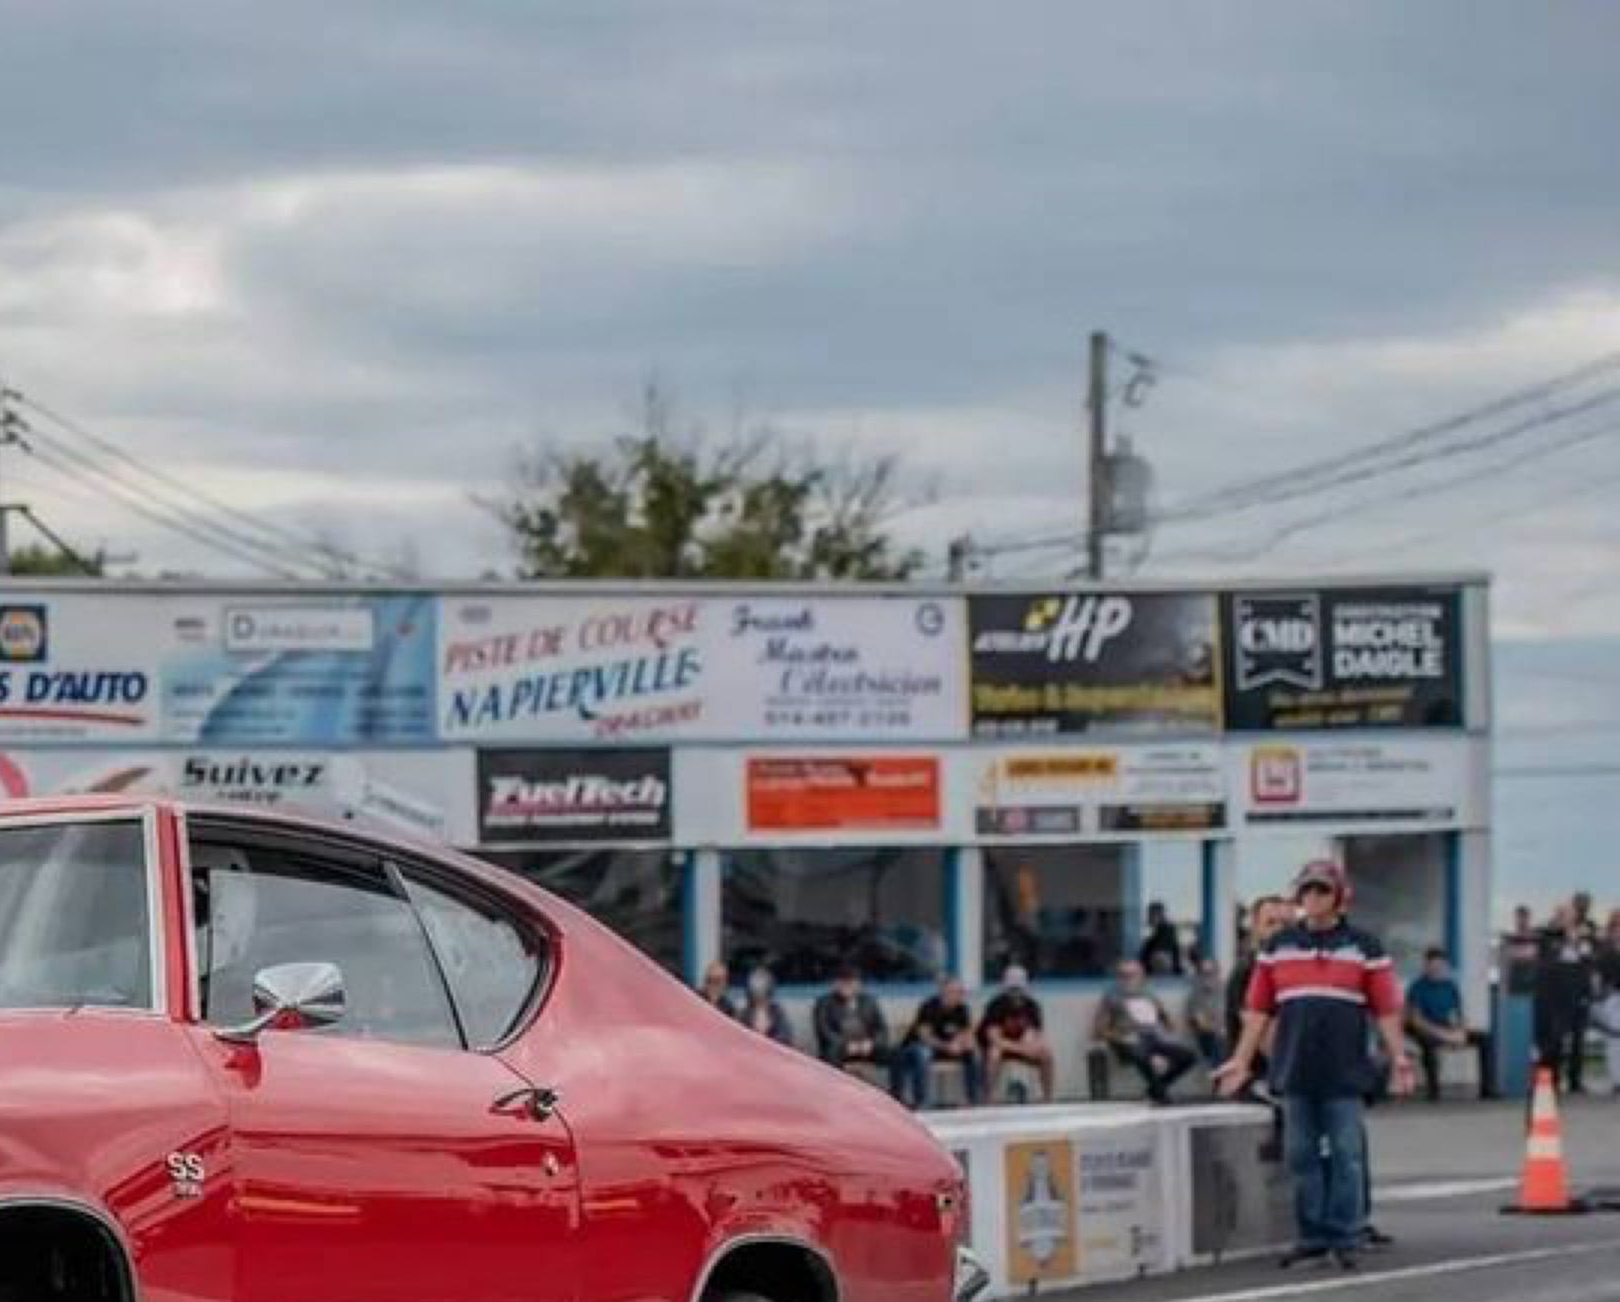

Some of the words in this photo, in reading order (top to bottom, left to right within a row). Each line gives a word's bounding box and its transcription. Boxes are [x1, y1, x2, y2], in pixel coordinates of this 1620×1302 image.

[445, 633, 519, 674] PISTE
[528, 626, 565, 659] DE
[580, 603, 699, 650] COURSE
[1047, 595, 1132, 662] HP
[24, 669, 149, 706] D'AUTO
[445, 648, 703, 730] NAPIERVILLE
[182, 756, 325, 787] Suivez
[490, 774, 667, 808] FuelTech
[167, 1151, 204, 1180] SS
